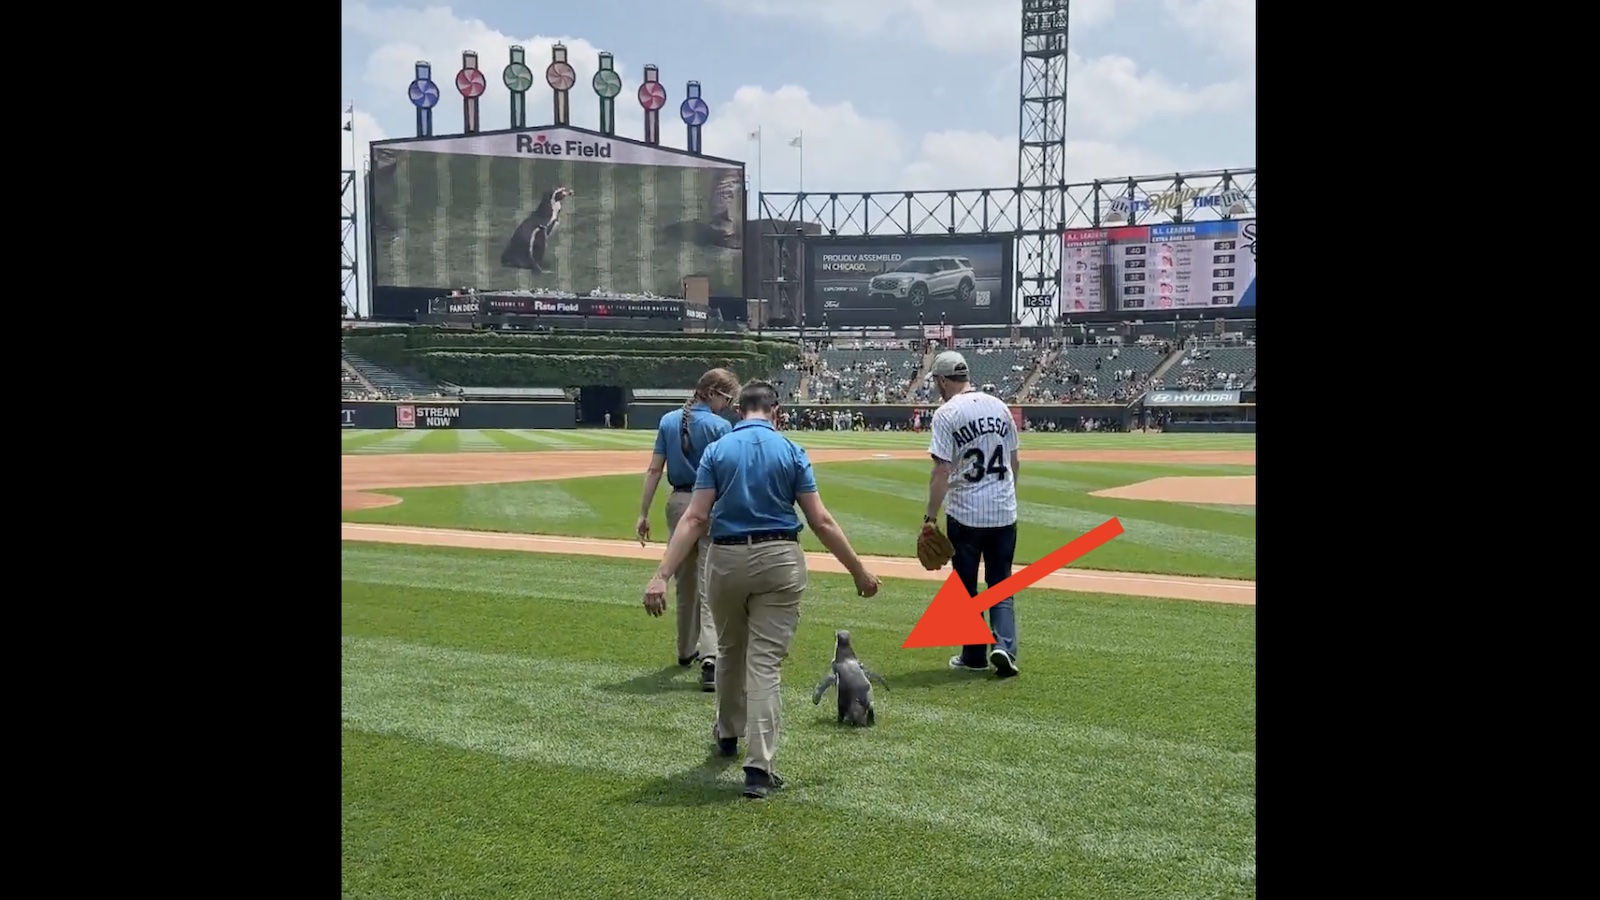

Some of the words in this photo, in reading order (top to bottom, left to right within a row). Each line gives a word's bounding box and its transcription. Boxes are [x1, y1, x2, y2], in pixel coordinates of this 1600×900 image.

[516, 134, 562, 155] Rate
[565, 140, 612, 158] Field
[1192, 196, 1221, 208] TIME
[823, 254, 857, 262] PROUDLY
[859, 254, 902, 262] ASSEMBLED
[823, 263, 831, 271] IN
[450, 304, 462, 313] FAN
[463, 303, 480, 312] DECK
[534, 301, 556, 311] Rate
[557, 302, 579, 312] Field
[686, 309, 696, 318] FAN
[1173, 393, 1233, 402] HYUNDAI
[416, 407, 460, 417] STREAM
[426, 417, 451, 427] NOW
[962, 444, 1008, 483] 34
